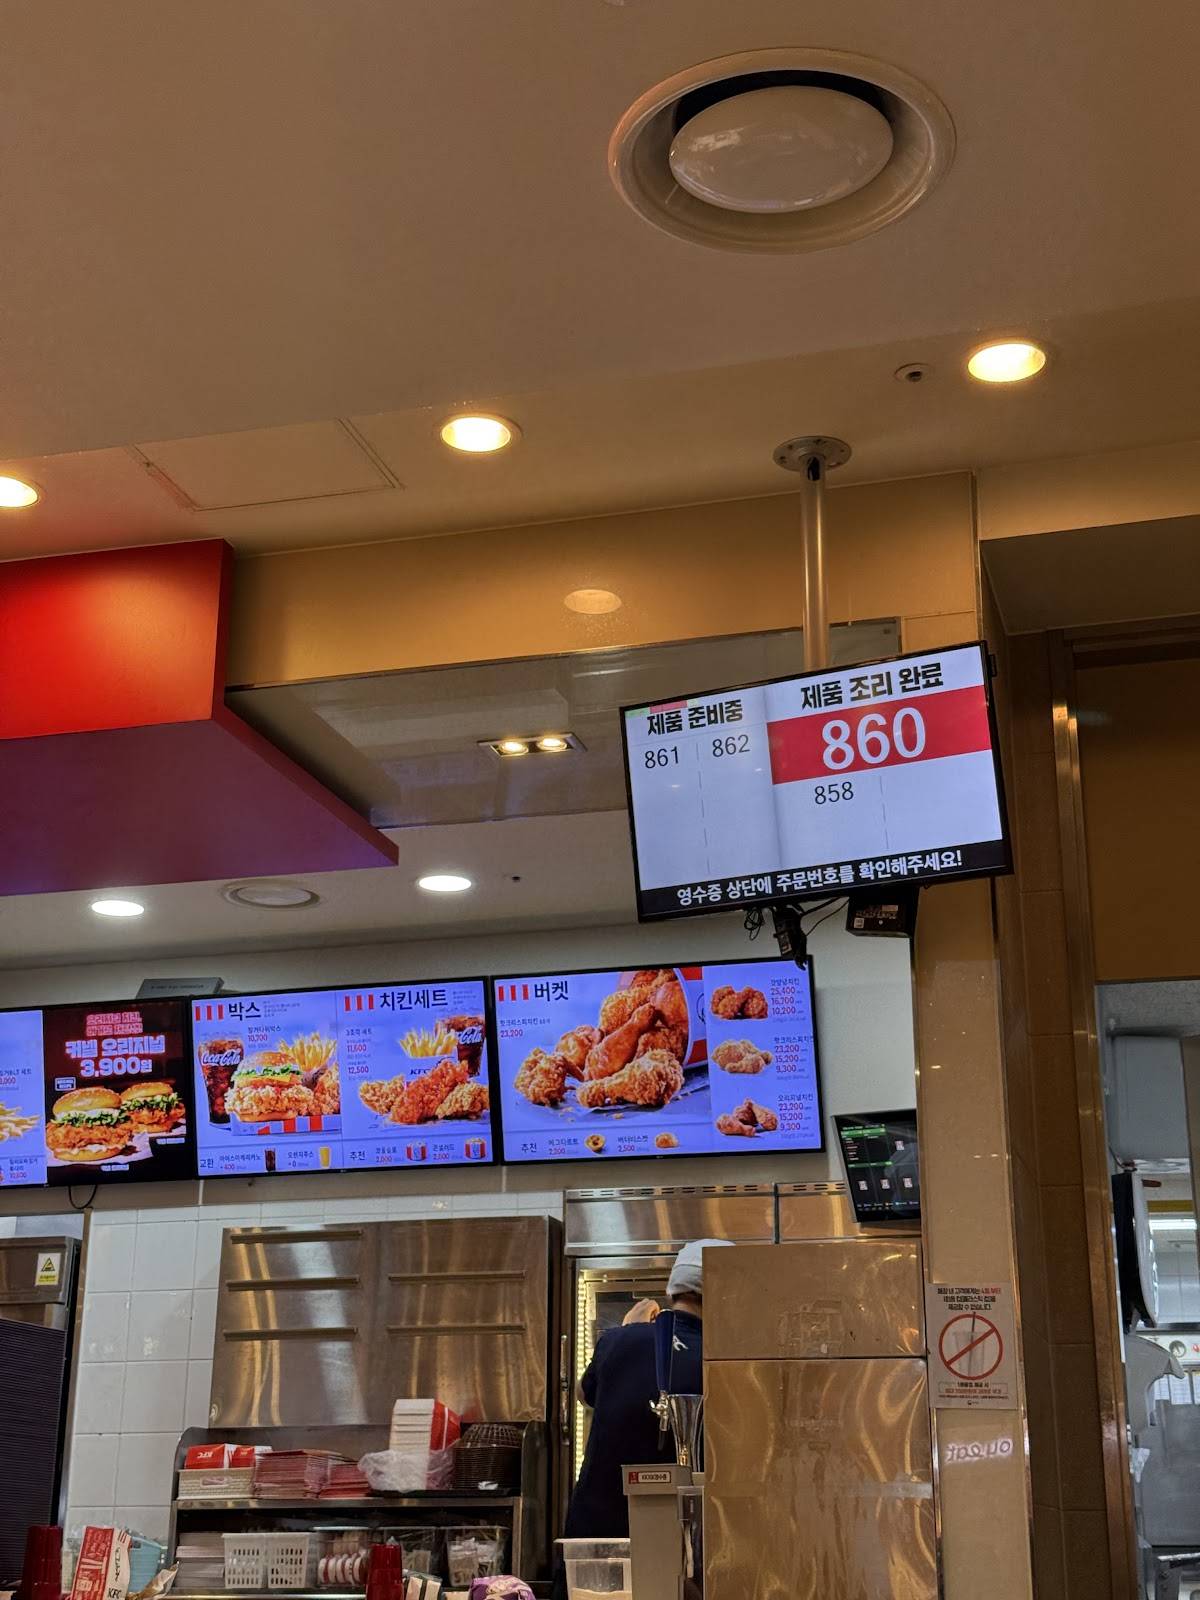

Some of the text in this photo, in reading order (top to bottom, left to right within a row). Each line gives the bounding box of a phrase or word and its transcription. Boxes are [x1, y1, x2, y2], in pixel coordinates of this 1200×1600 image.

[801, 662, 944, 710] 제품 조리 완료
[647, 699, 743, 736] 제품 준비중
[821, 706, 927, 771] 860
[644, 734, 751, 770] 861 862
[813, 781, 855, 806] 858
[676, 849, 963, 906] 영수증 상단에 주문번호를 확인해주세요!
[379, 989, 449, 1011] 치킨세트
[534, 981, 569, 1002] 버켓
[228, 1001, 261, 1021] 박스
[500, 1017, 538, 1027] 핫크리스피치킨
[101, 1035, 165, 1057] 오리지널
[202, 1048, 242, 1067] Coca-Cola
[521, 1142, 537, 1153] 추천
[548, 1137, 579, 1147] 에그타르트
[200, 1158, 214, 1169] 교환
[287, 1150, 314, 1159] 오렌지주스
[350, 1151, 367, 1161] 추천
